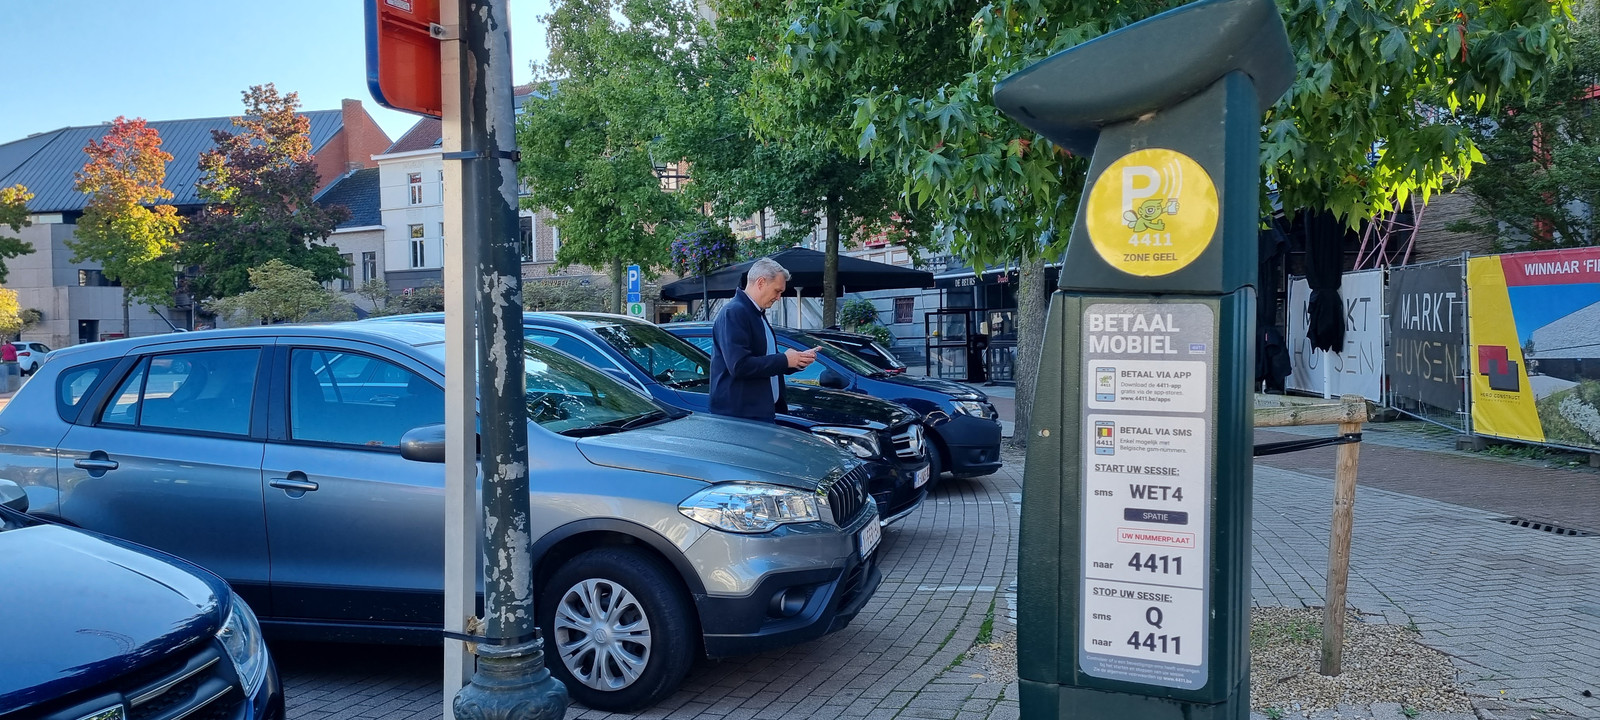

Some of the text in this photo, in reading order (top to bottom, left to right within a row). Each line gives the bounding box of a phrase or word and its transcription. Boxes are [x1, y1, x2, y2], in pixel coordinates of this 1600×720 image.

[1122, 165, 1161, 225] P
[1128, 232, 1173, 247] 4411
[1123, 252, 1178, 262] ZONE GEEL
[1524, 260, 1580, 276] WINNAAR
[629, 270, 638, 289] P
[1401, 292, 1457, 333] MARKT
[1088, 313, 1180, 332] BETAAL
[1088, 334, 1178, 354] MOBIEL
[1294, 337, 1375, 376] HUSEN
[1395, 337, 1458, 385] HUYSEN
[1121, 370, 1192, 379] BETAAL VIA APP
[1120, 381, 1148, 389] Download
[1156, 382, 1182, 390] 4411-app
[1120, 426, 1192, 437] BETAAL VIA SMS
[1120, 444, 1145, 452] Belgische
[1135, 438, 1158, 446] mogelijk
[1094, 463, 1180, 476] START UW SESSIE:
[1094, 489, 1114, 497] sms
[1142, 512, 1169, 521] SPATIE
[1121, 532, 1191, 544] UW NUMMERPLAAT
[1093, 552, 1182, 576] naar 4411
[1092, 586, 1173, 602] STOP UW SESSIE:
[1092, 606, 1164, 630] sms Q
[1092, 630, 1181, 655] naar 4411
